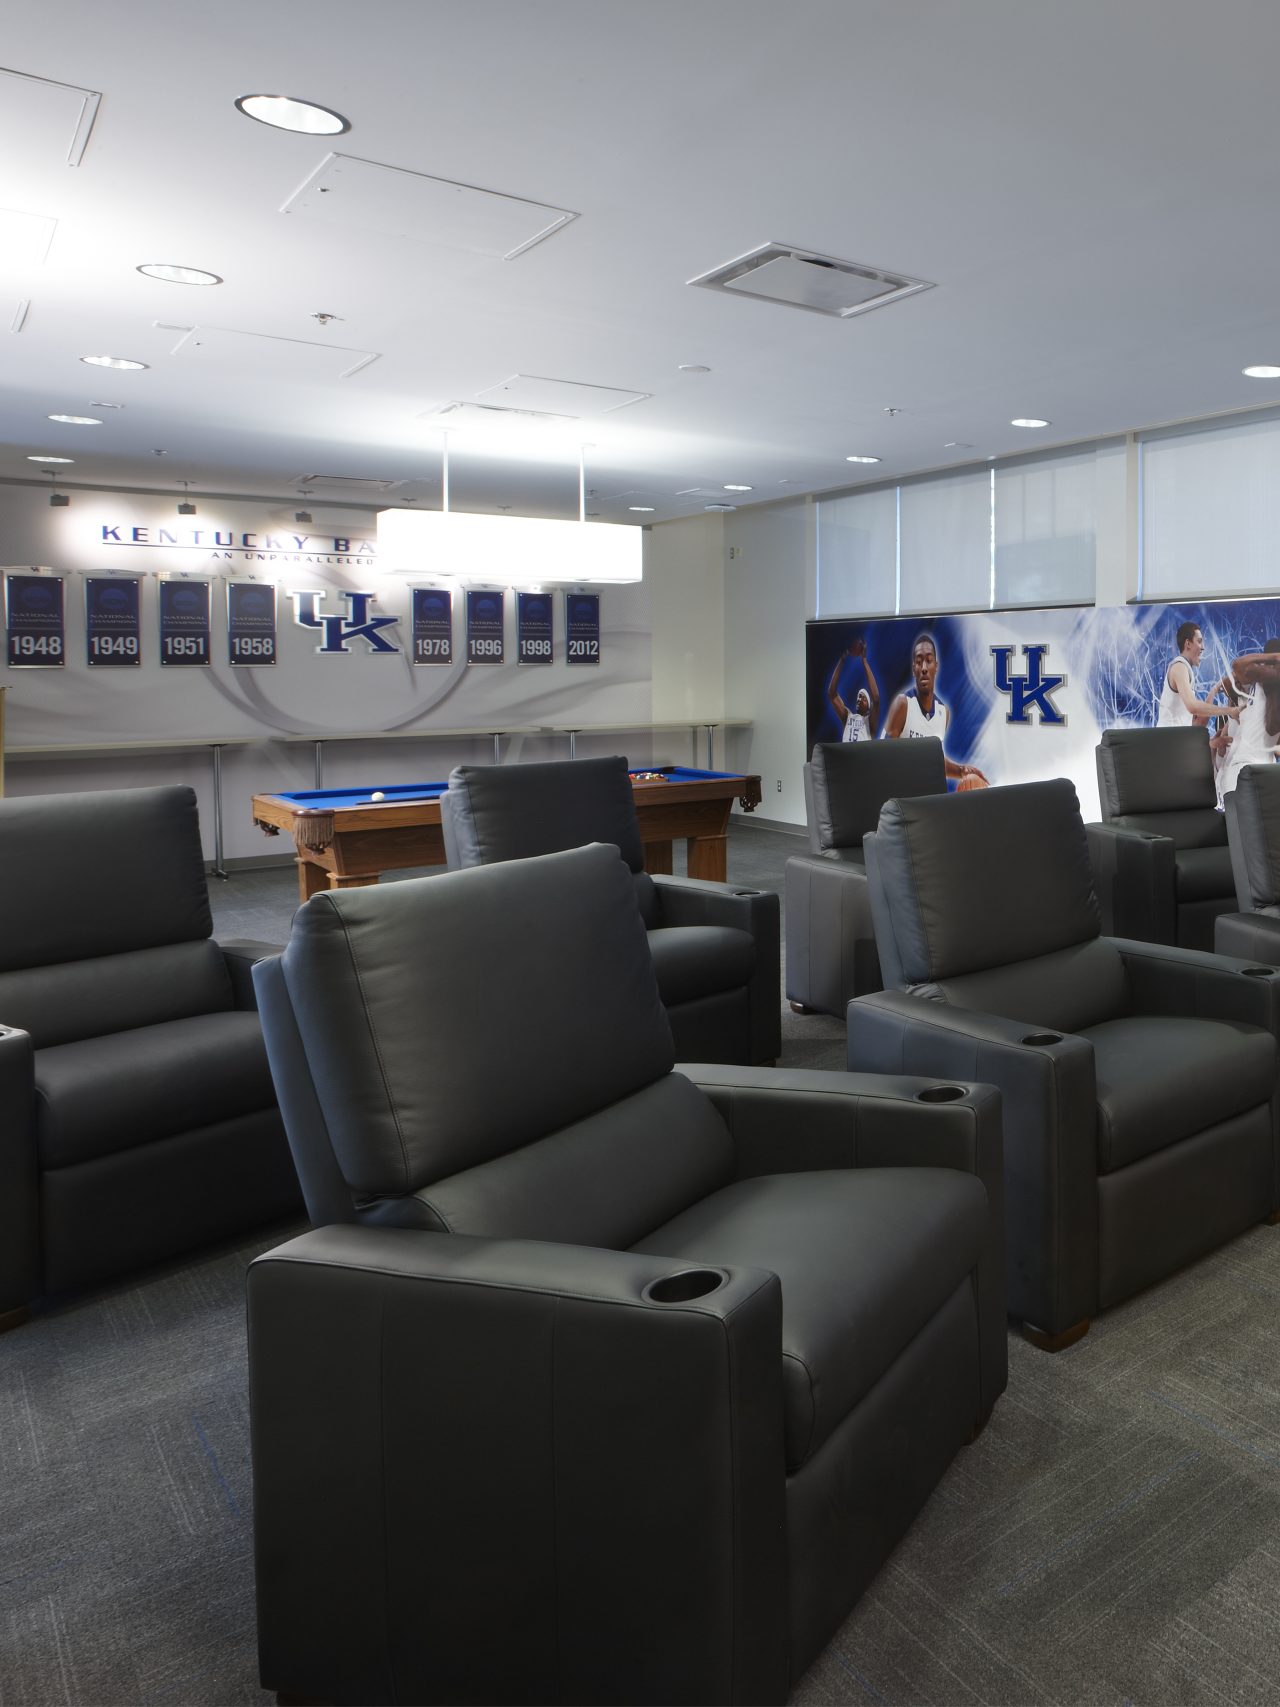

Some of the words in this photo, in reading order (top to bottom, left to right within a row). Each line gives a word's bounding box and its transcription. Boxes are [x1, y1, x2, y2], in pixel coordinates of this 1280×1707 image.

[102, 525, 309, 549] KENTUCKY
[211, 551, 233, 559] AN
[245, 553, 373, 565] UNPARALLELED
[11, 636, 62, 655] 1948
[91, 636, 138, 655] 1949
[165, 637, 204, 655] 1951
[232, 638, 273, 656] 1958
[416, 639, 450, 655] 1978
[470, 639, 502, 656] 1996
[521, 640, 551, 656] 1998
[569, 640, 598, 656] 2012
[990, 644, 1068, 727] UK
